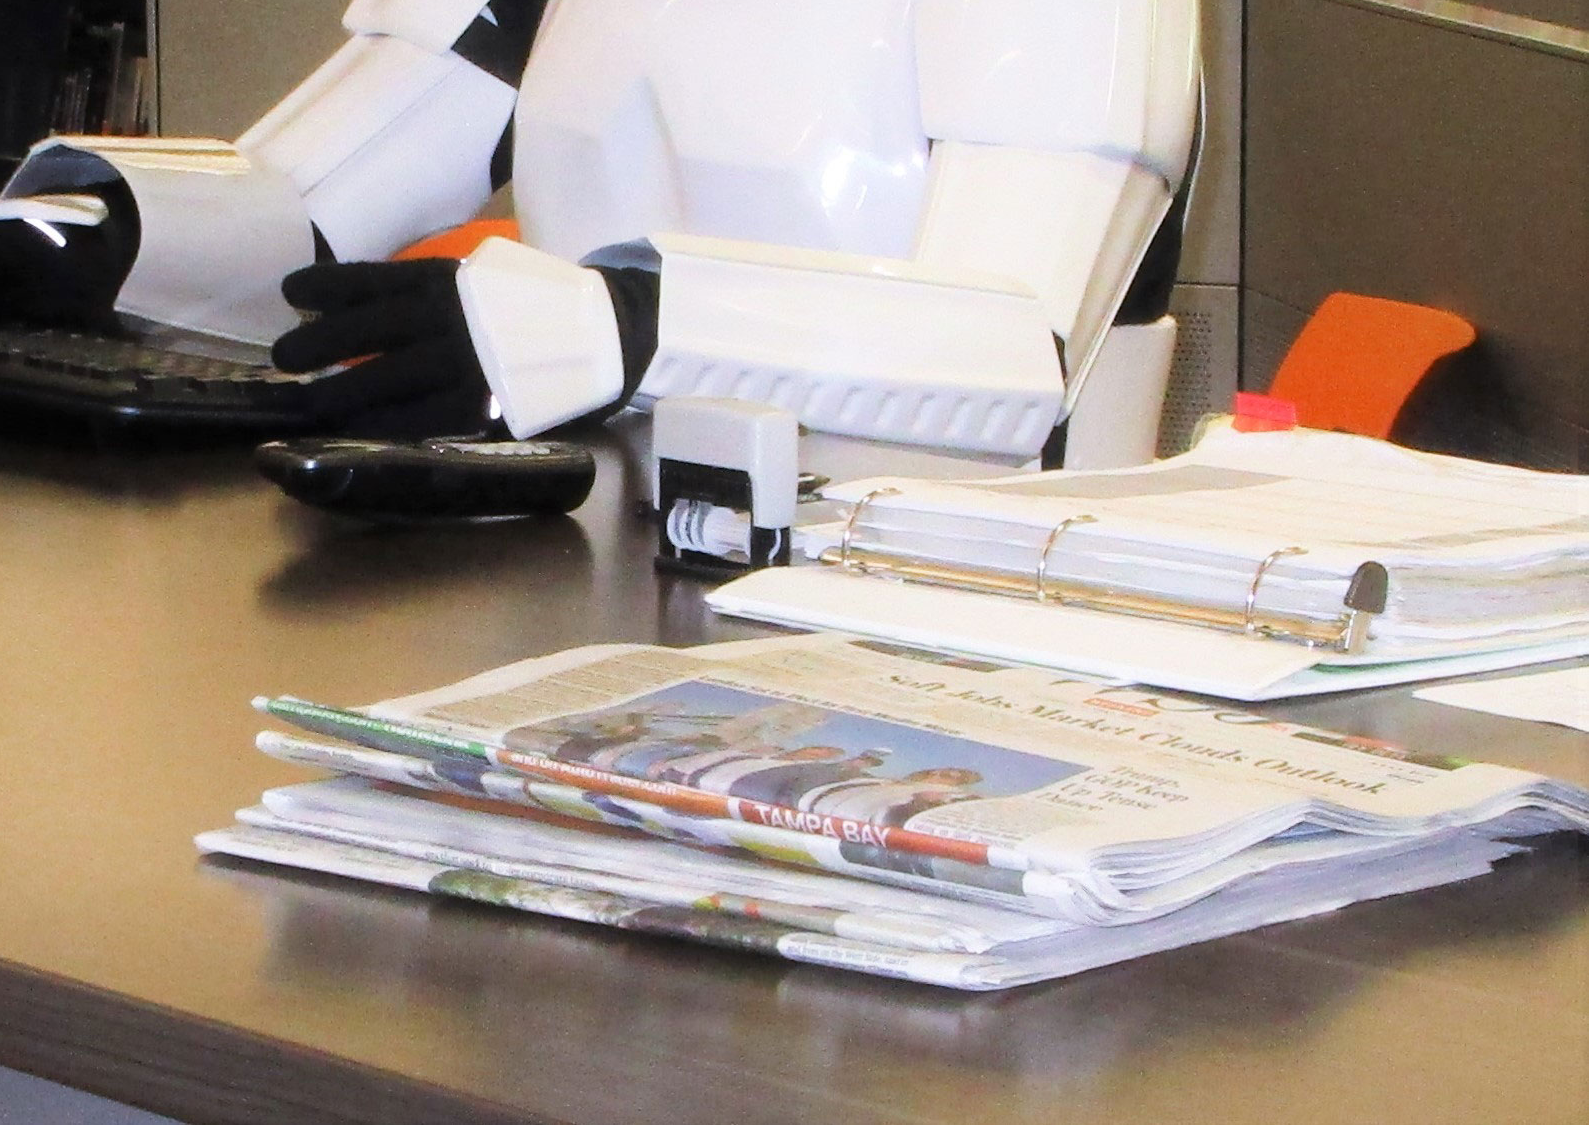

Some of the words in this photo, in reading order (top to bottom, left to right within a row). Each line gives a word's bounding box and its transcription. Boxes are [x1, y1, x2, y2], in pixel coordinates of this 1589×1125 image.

[889, 674, 947, 692] Soft
[945, 689, 1013, 709] Jobs
[1029, 704, 1135, 737] Market
[1138, 731, 1249, 763] Clouds
[1253, 758, 1387, 796] Outlook
[752, 803, 841, 840] TAMPA
[841, 820, 892, 849] BAY
